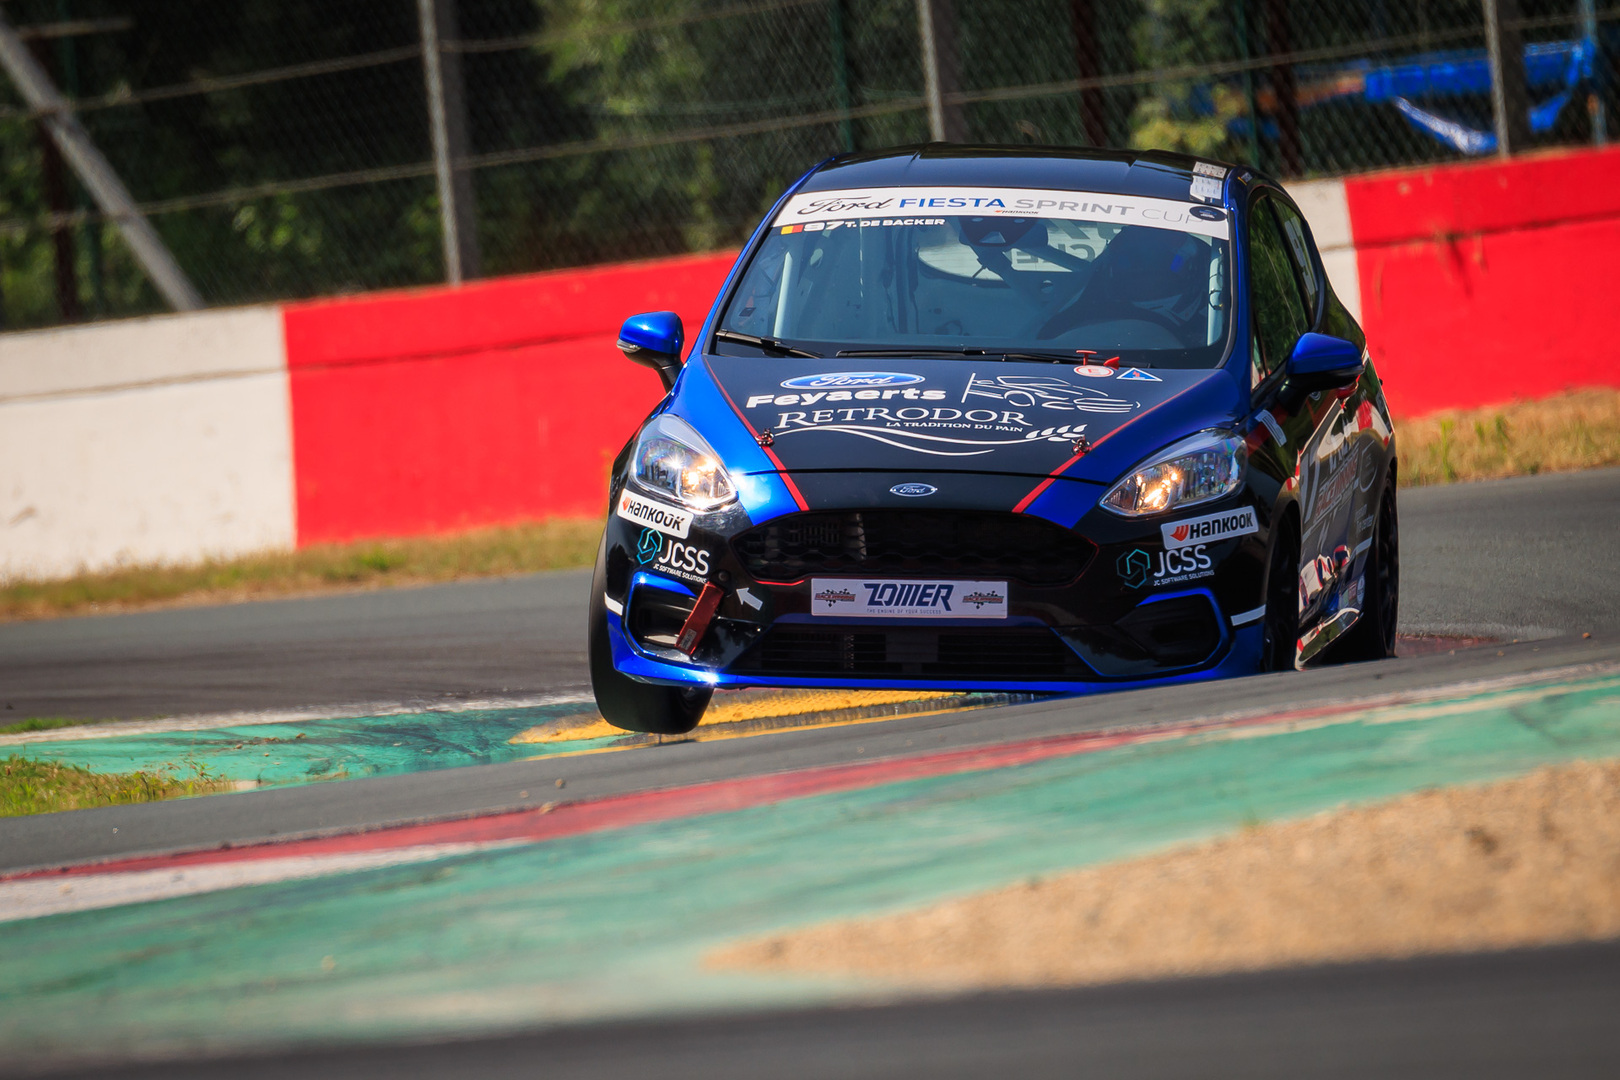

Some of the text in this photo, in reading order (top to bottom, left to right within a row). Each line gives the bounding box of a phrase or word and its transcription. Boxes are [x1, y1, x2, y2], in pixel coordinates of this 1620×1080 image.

[797, 196, 894, 215] Ford
[899, 197, 1006, 209] FIESTA
[1015, 199, 1135, 216] SPRINT
[803, 220, 844, 232] 97
[860, 219, 879, 227] DE
[882, 218, 946, 226] BACKER
[810, 374, 896, 387] Ford
[746, 388, 947, 408] Feyaerts
[773, 407, 1033, 429] RETRODOR
[903, 421, 971, 429] TRADITION
[995, 425, 1023, 433] PAIN
[899, 485, 926, 494] Ford
[658, 540, 710, 576] JCSS
[1153, 544, 1212, 578] JCSS
[659, 564, 682, 577] SOFTWARE
[682, 571, 707, 584] SOLUTIONS
[1161, 574, 1189, 585] SOFTWARE
[1189, 569, 1215, 580] SOLUTIONS
[863, 583, 954, 612] ZOMER
